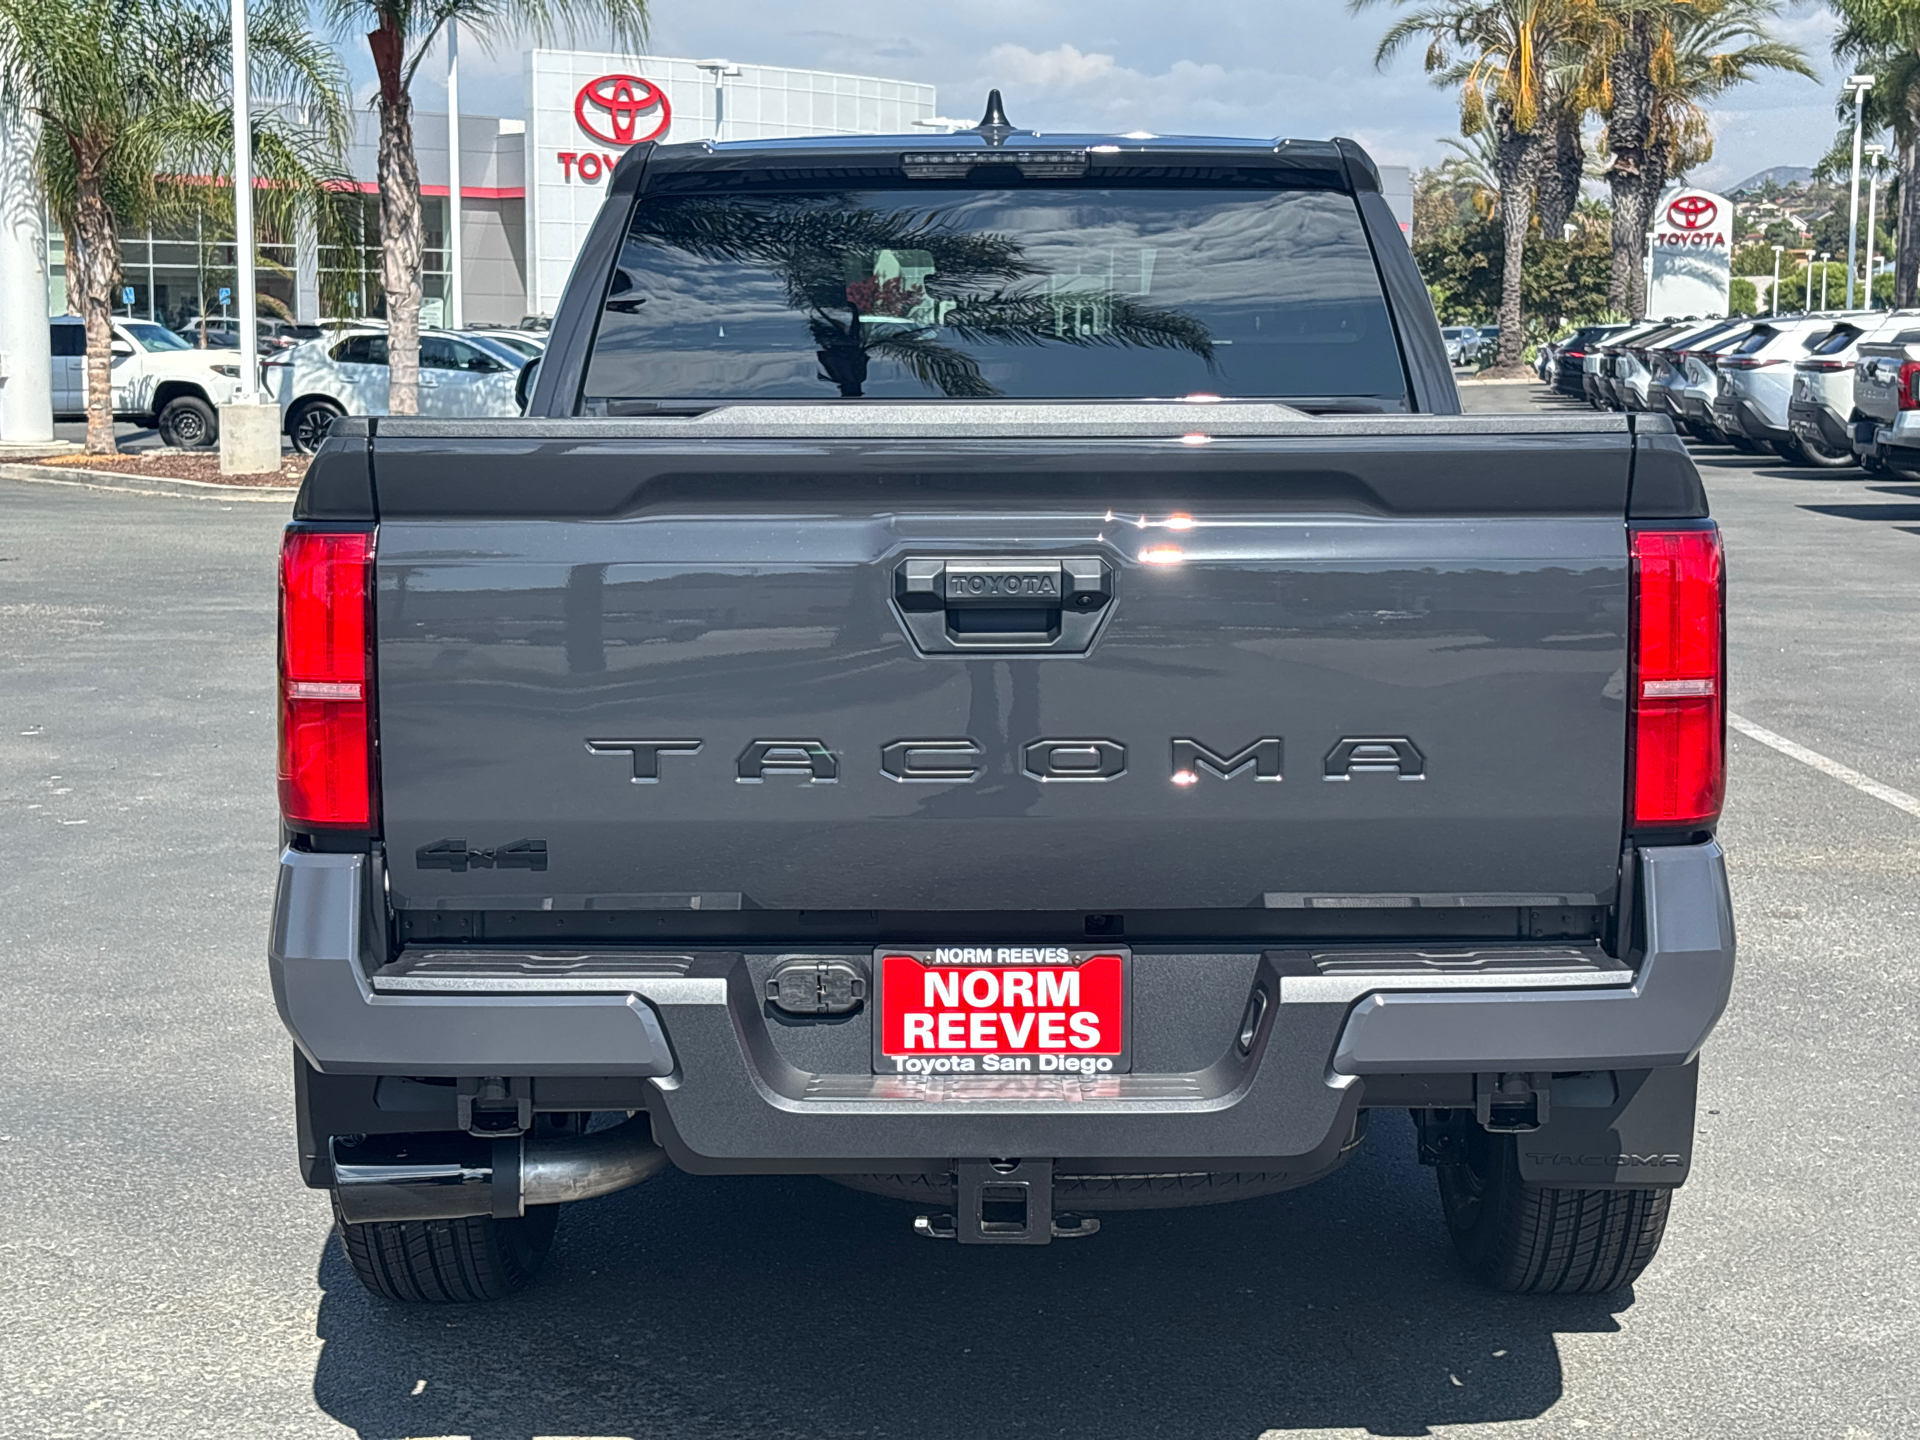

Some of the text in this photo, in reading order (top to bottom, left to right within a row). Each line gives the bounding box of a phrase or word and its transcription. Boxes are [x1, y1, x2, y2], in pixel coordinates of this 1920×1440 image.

[1658, 232, 1725, 246] TOYOTA
[952, 575, 1056, 594] TOYOTA
[585, 737, 1426, 784] TACOMA
[936, 948, 1069, 963] NORM REEVES
[924, 970, 1080, 1008] NORM
[903, 1011, 1101, 1049] REEVES
[891, 1053, 1113, 1075] Toyota San Diego
[1526, 1152, 1684, 1167] TACOMA
